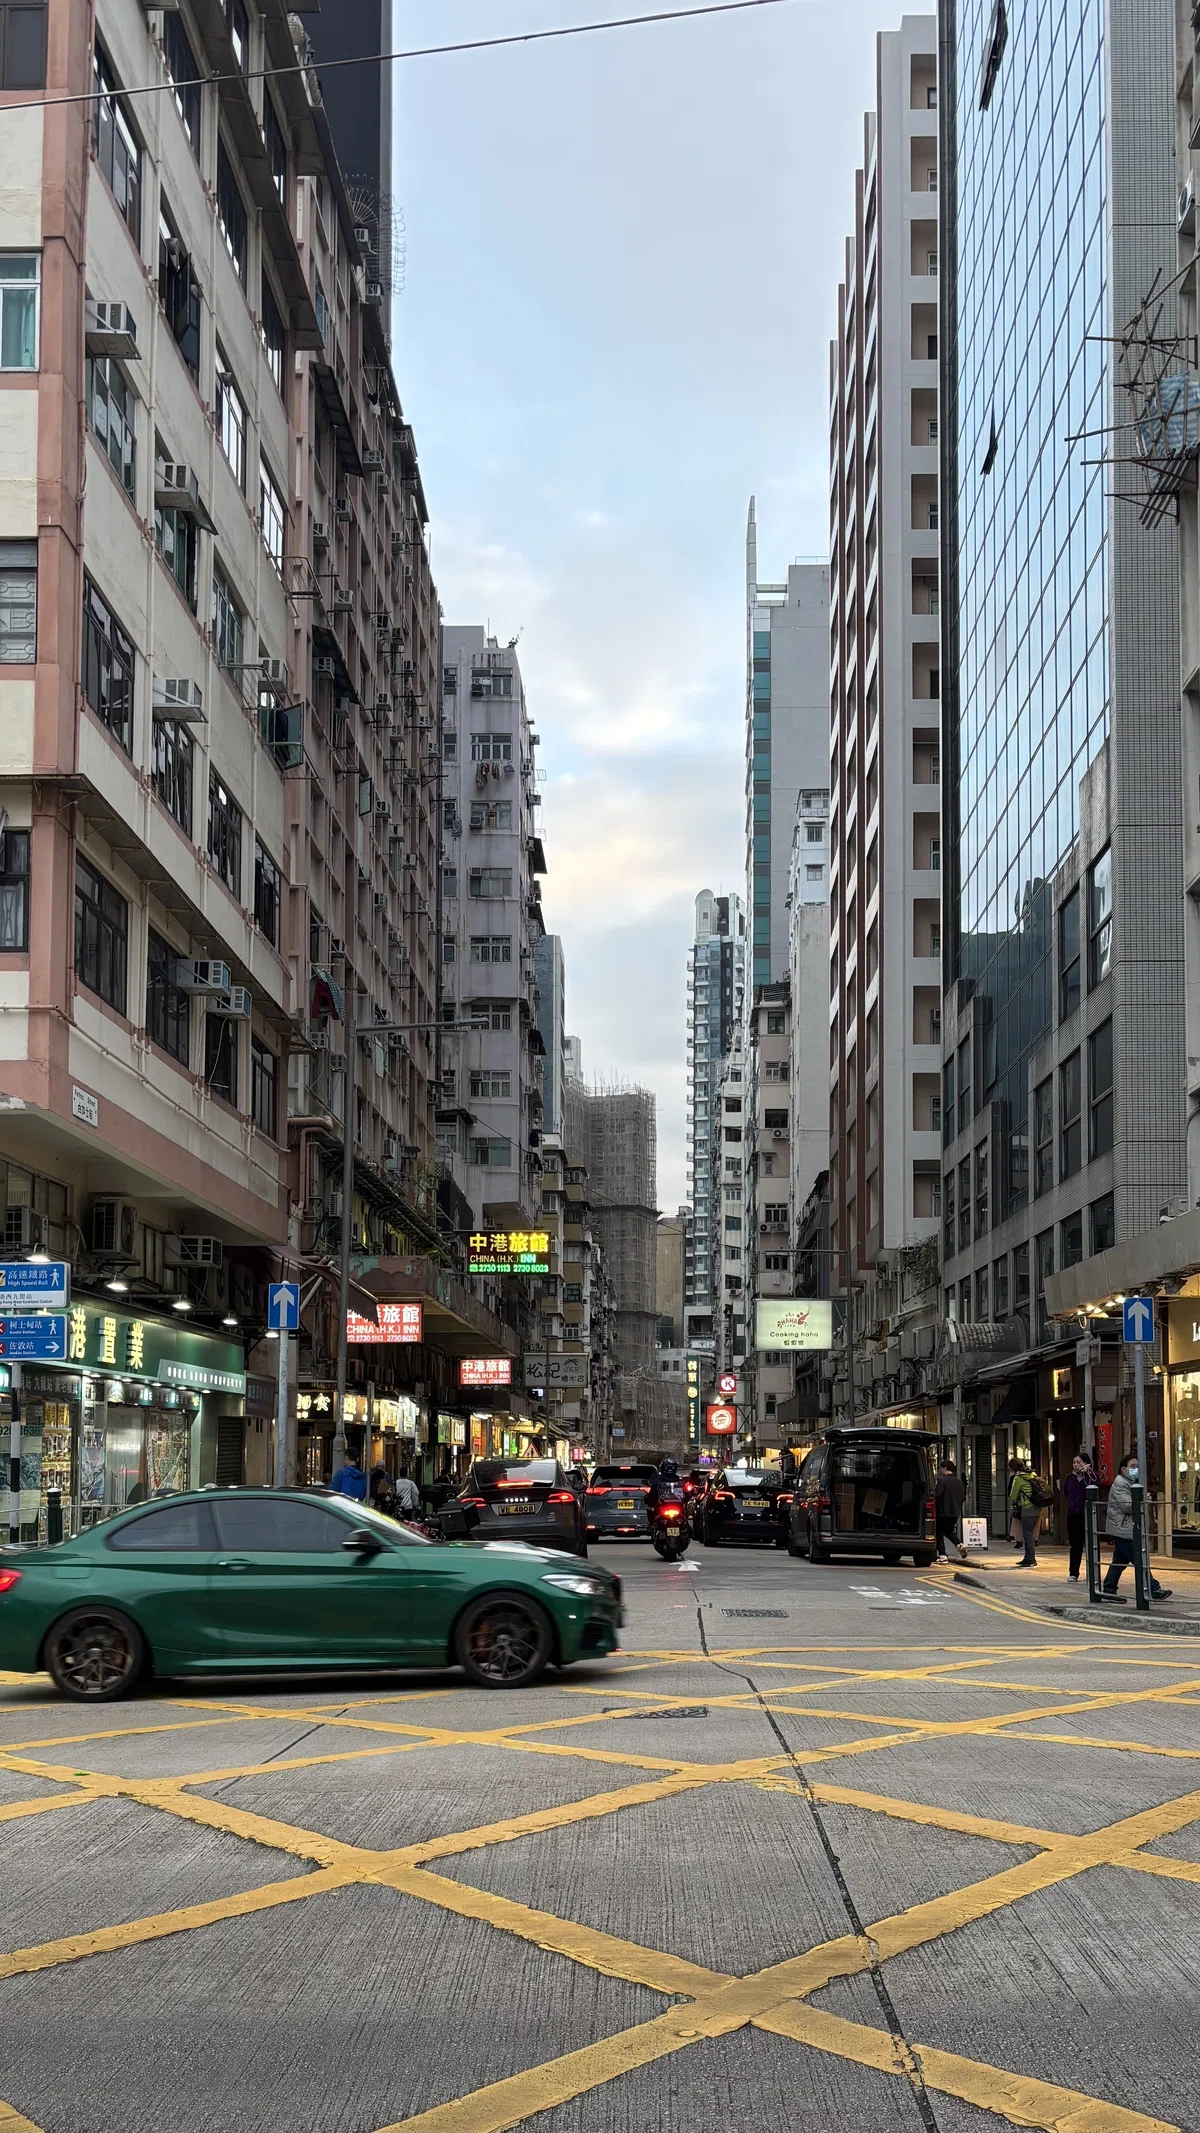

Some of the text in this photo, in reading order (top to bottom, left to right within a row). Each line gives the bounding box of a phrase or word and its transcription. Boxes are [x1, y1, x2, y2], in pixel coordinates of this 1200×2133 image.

[87, 1097, 96, 1108] Street
[469, 1232, 549, 1253] 中港旅館
[469, 1253, 537, 1264] CHINA (H.K.) INN
[478, 1264, 549, 1273] 2730 1113 2730 8023
[8, 1270, 48, 1280] 高速鐵路
[9, 1321, 43, 1329] 柯士甸站
[347, 1324, 419, 1334] CHINA (H.K.) INN
[38, 1307, 144, 1370] 港置業
[9, 1341, 34, 1350] 佐敦站
[461, 1360, 510, 1372] 中港旅館
[526, 1362, 561, 1378] 松記
[209, 1374, 242, 1389] PROPERTY
